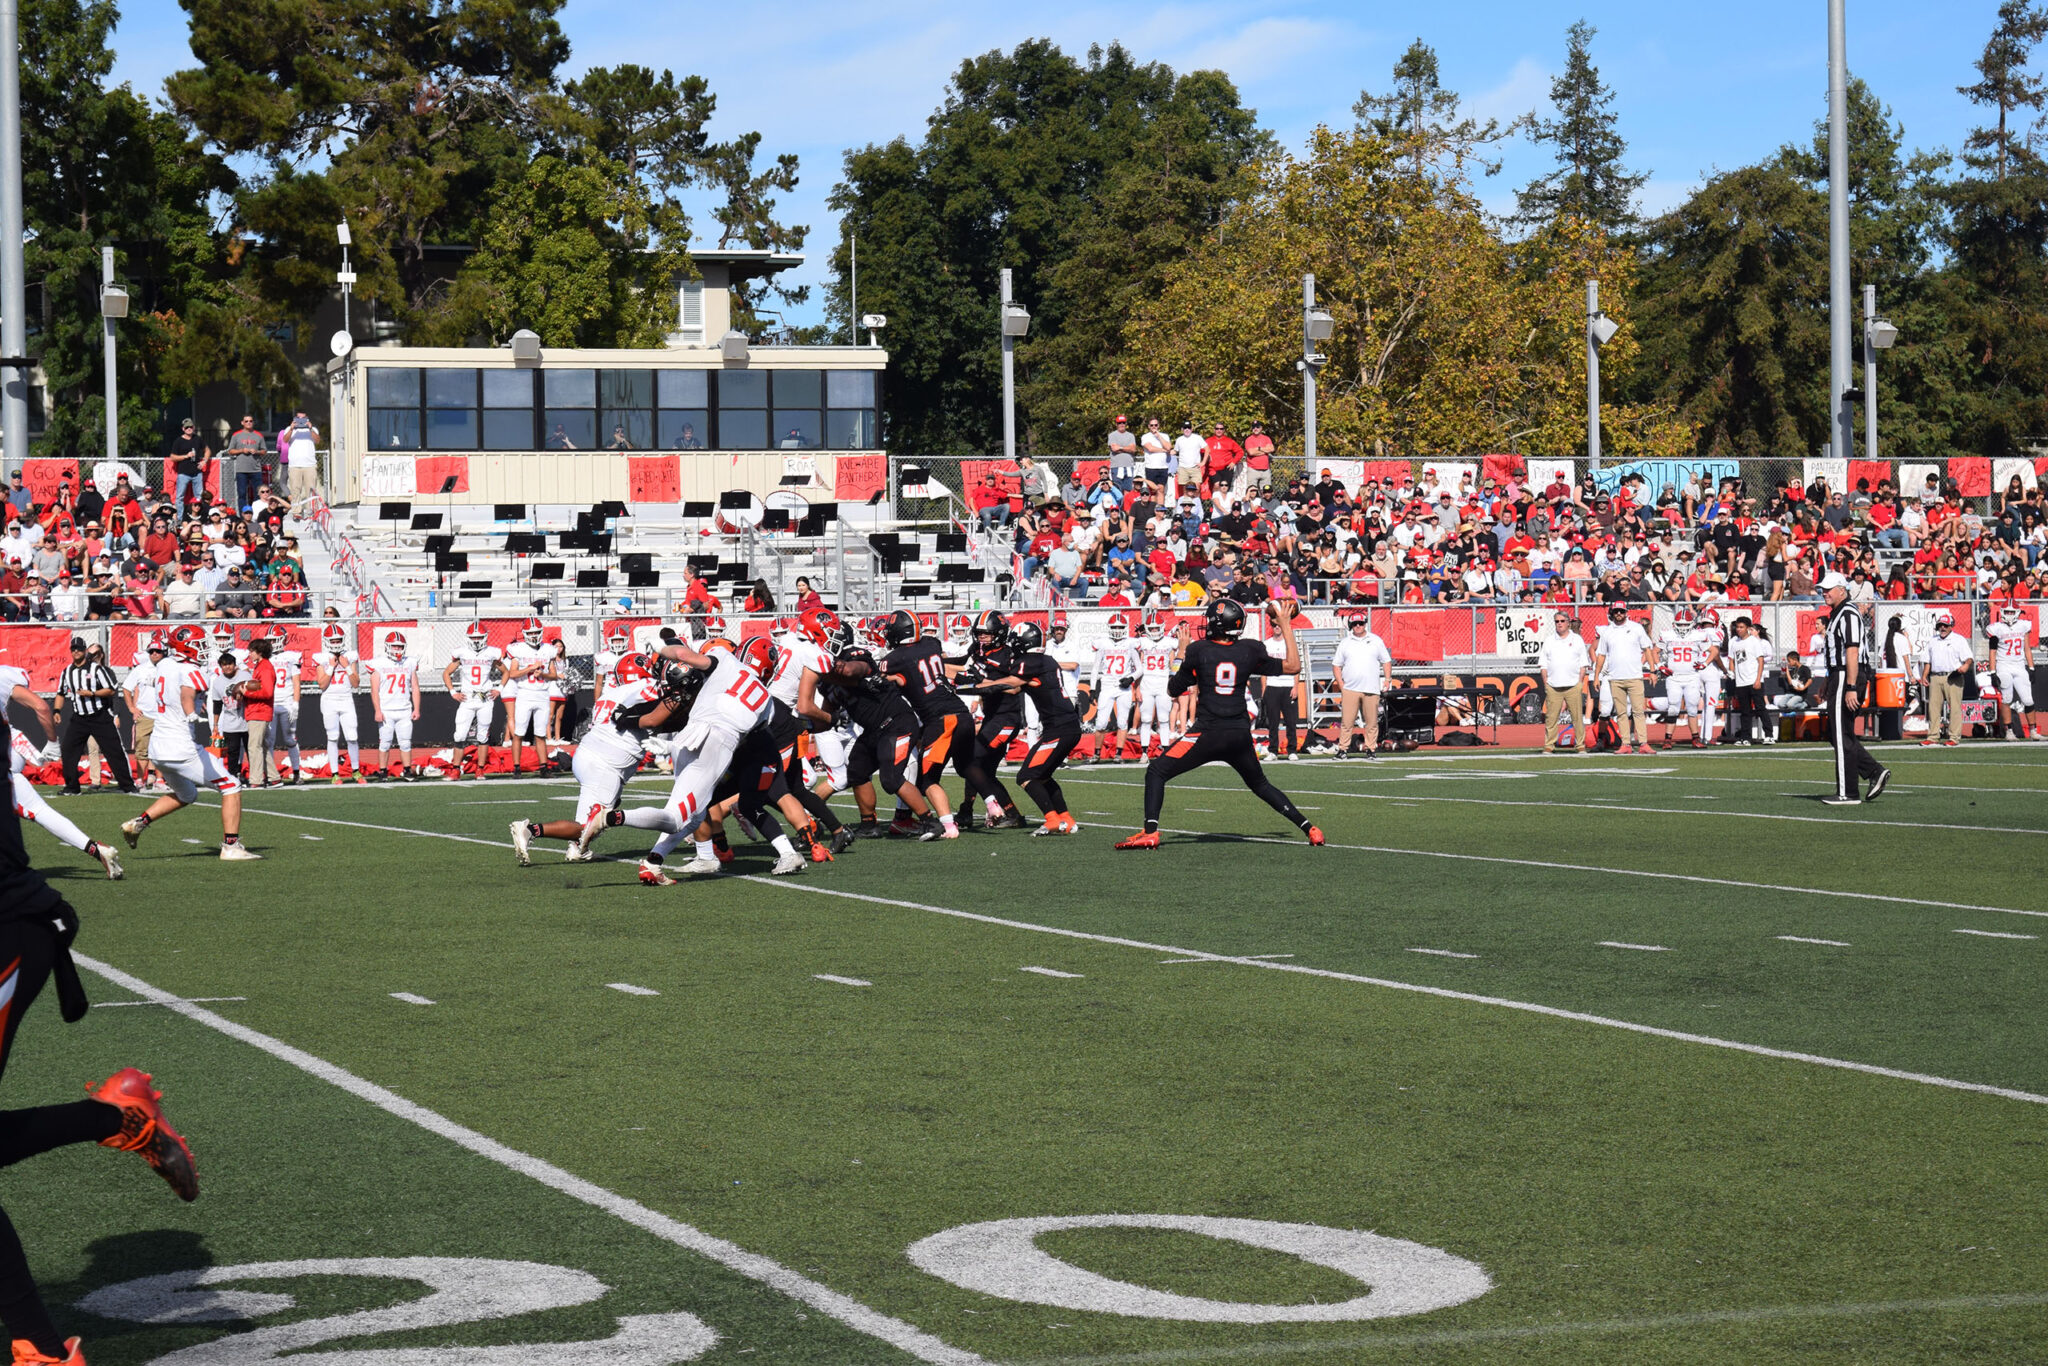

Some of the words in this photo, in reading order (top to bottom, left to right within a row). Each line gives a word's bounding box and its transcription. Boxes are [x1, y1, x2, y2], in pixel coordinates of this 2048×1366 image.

[371, 459, 414, 477] PANTHERS
[839, 460, 857, 470] WE
[863, 459, 880, 470] ARE
[1811, 462, 1844, 474] PANTHER
[32, 466, 56, 480] GO
[838, 471, 883, 484] PANTHERS!
[366, 477, 408, 494] RULE
[1215, 602, 1226, 614] 9
[1396, 615, 1419, 631] Show
[1498, 616, 1512, 631] GO
[1507, 628, 1526, 643] BIG
[1672, 647, 1692, 662] 56
[2004, 638, 2023, 656] 72
[1017, 661, 1026, 675] 1
[1105, 655, 1125, 675] 73
[1146, 655, 1165, 671] 64
[471, 666, 481, 685] 9
[918, 653, 945, 695] 10
[1214, 661, 1238, 696] 9
[386, 673, 406, 694] 74
[725, 669, 769, 712] 10
